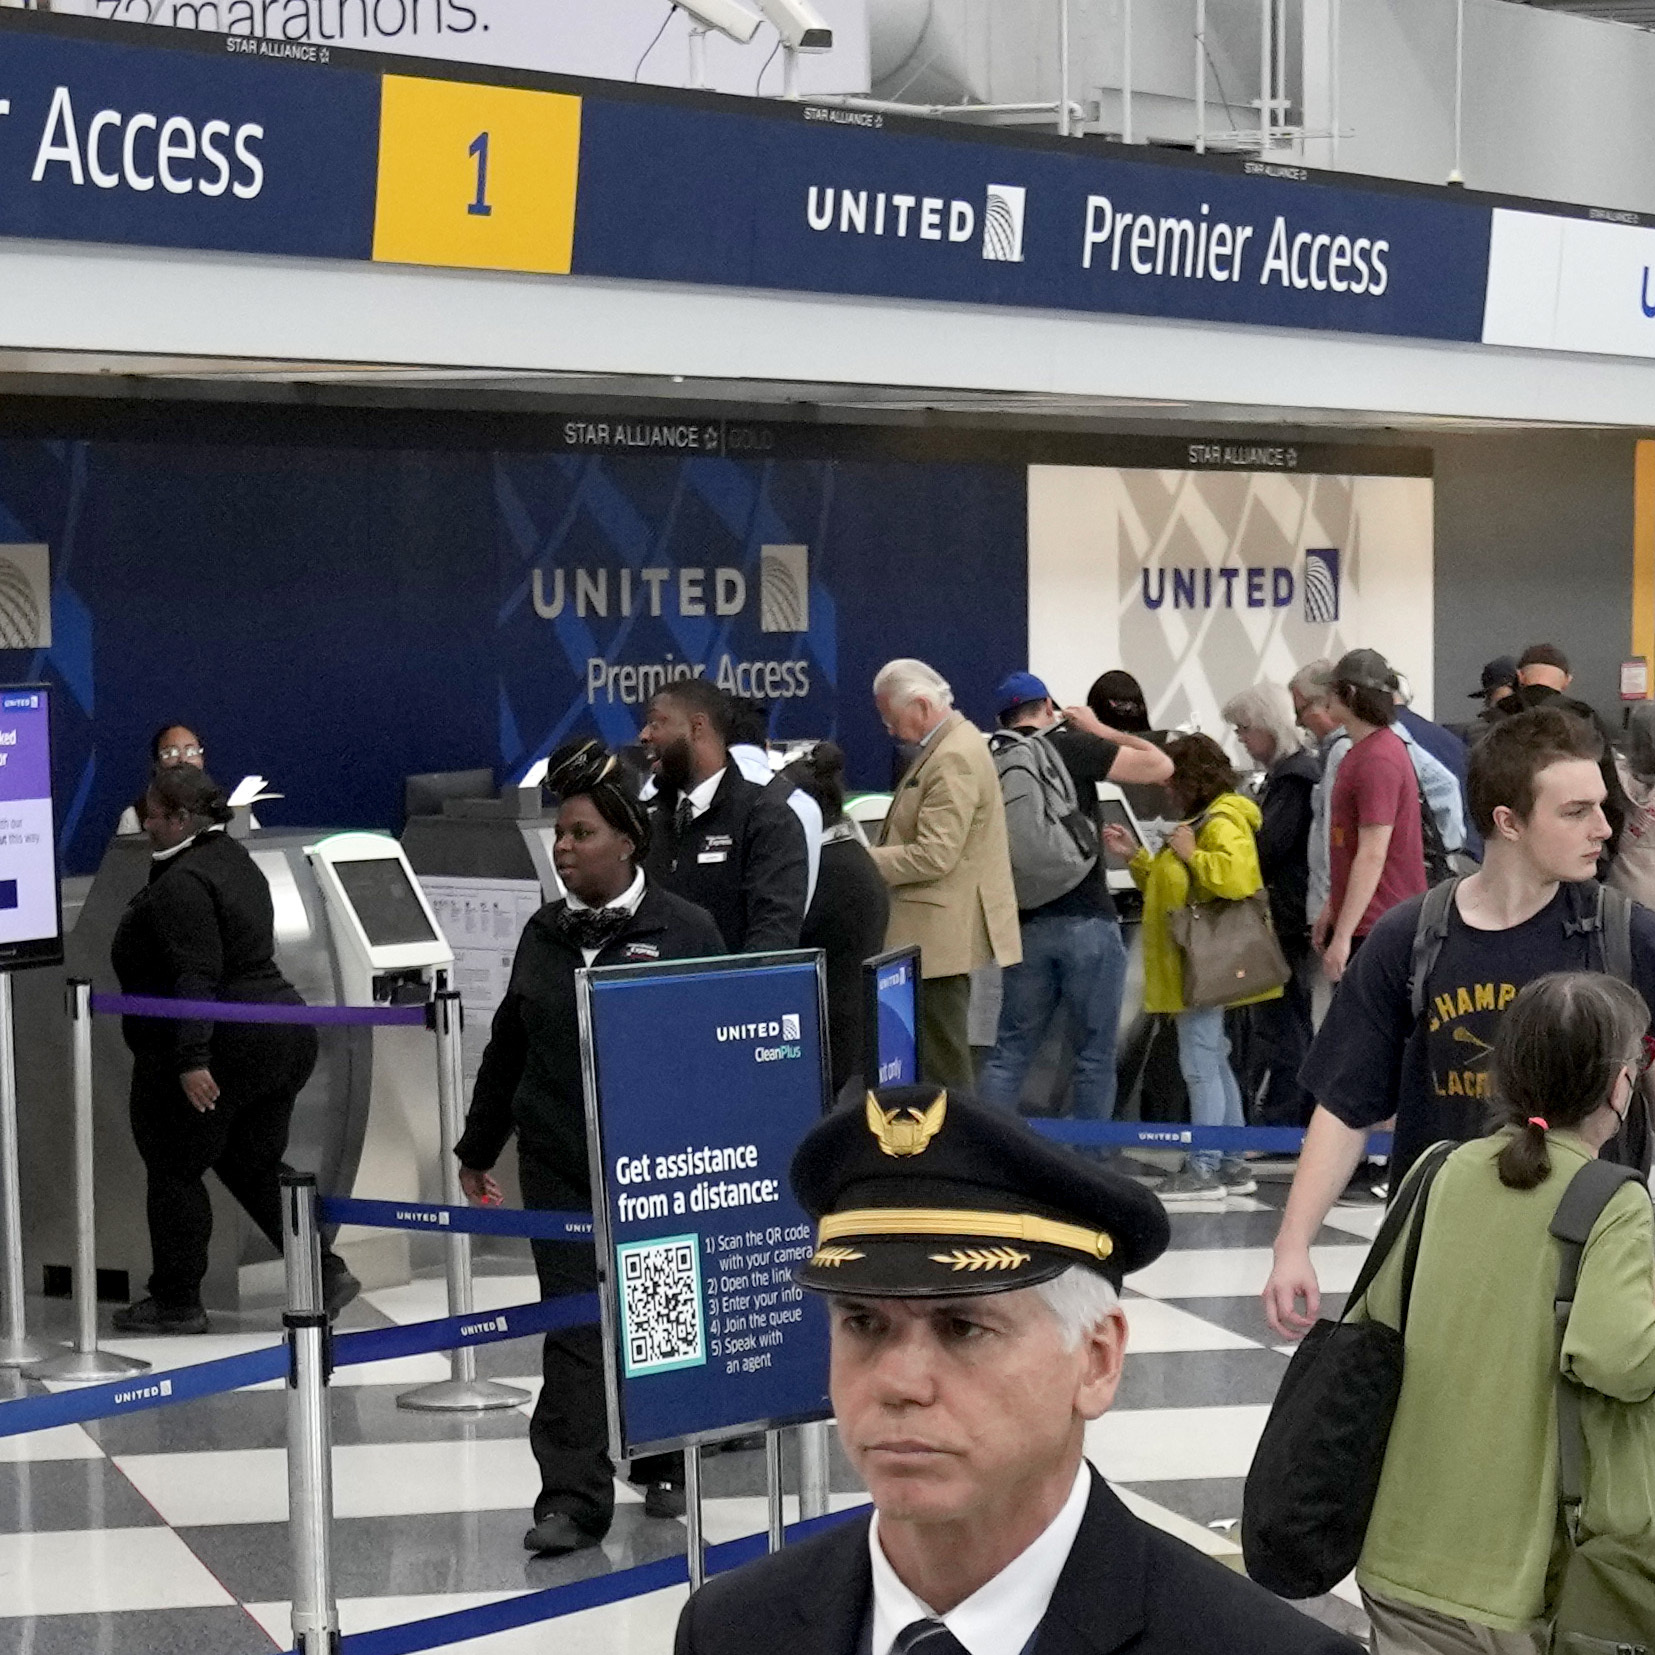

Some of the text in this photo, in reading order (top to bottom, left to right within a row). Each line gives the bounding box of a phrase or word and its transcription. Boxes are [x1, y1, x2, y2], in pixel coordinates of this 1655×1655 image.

[226, 38, 317, 61] STAR ALLIANCE
[803, 107, 874, 128] STAR ALLIANCE
[31, 86, 265, 200] Access
[467, 131, 492, 217] 1
[807, 186, 975, 242] UNITED
[1082, 195, 1390, 296] Premier Access
[564, 422, 610, 445] STAR
[614, 425, 699, 449] ALLIANCE
[1188, 445, 1284, 466] STAR ALLIANCE
[532, 567, 746, 620] UNITED
[1142, 567, 1294, 610] UNITED
[715, 653, 810, 700] Access
[0, 729, 17, 746] ked
[1428, 982, 1518, 1033] HAMP
[716, 1022, 780, 1042] UNITED
[755, 1044, 801, 1062] CleanPlus
[1434, 1070, 1493, 1099] LACR
[616, 1144, 758, 1185] Get assistance
[618, 1178, 779, 1223] from a distance:
[396, 1211, 438, 1223] UNITED
[565, 1223, 593, 1233] UNIT
[705, 1223, 810, 1254] 1) Scan the QR code
[719, 1245, 813, 1271] with your camera
[707, 1267, 793, 1295] 2) Open the link
[708, 1286, 803, 1316] 3) Enter your info
[460, 1321, 496, 1337] UNITED
[710, 1307, 802, 1336] 4) Join the queue
[711, 1331, 783, 1357] 5) Speak with
[726, 1352, 772, 1375] an agent
[114, 1386, 159, 1404] UNITED
